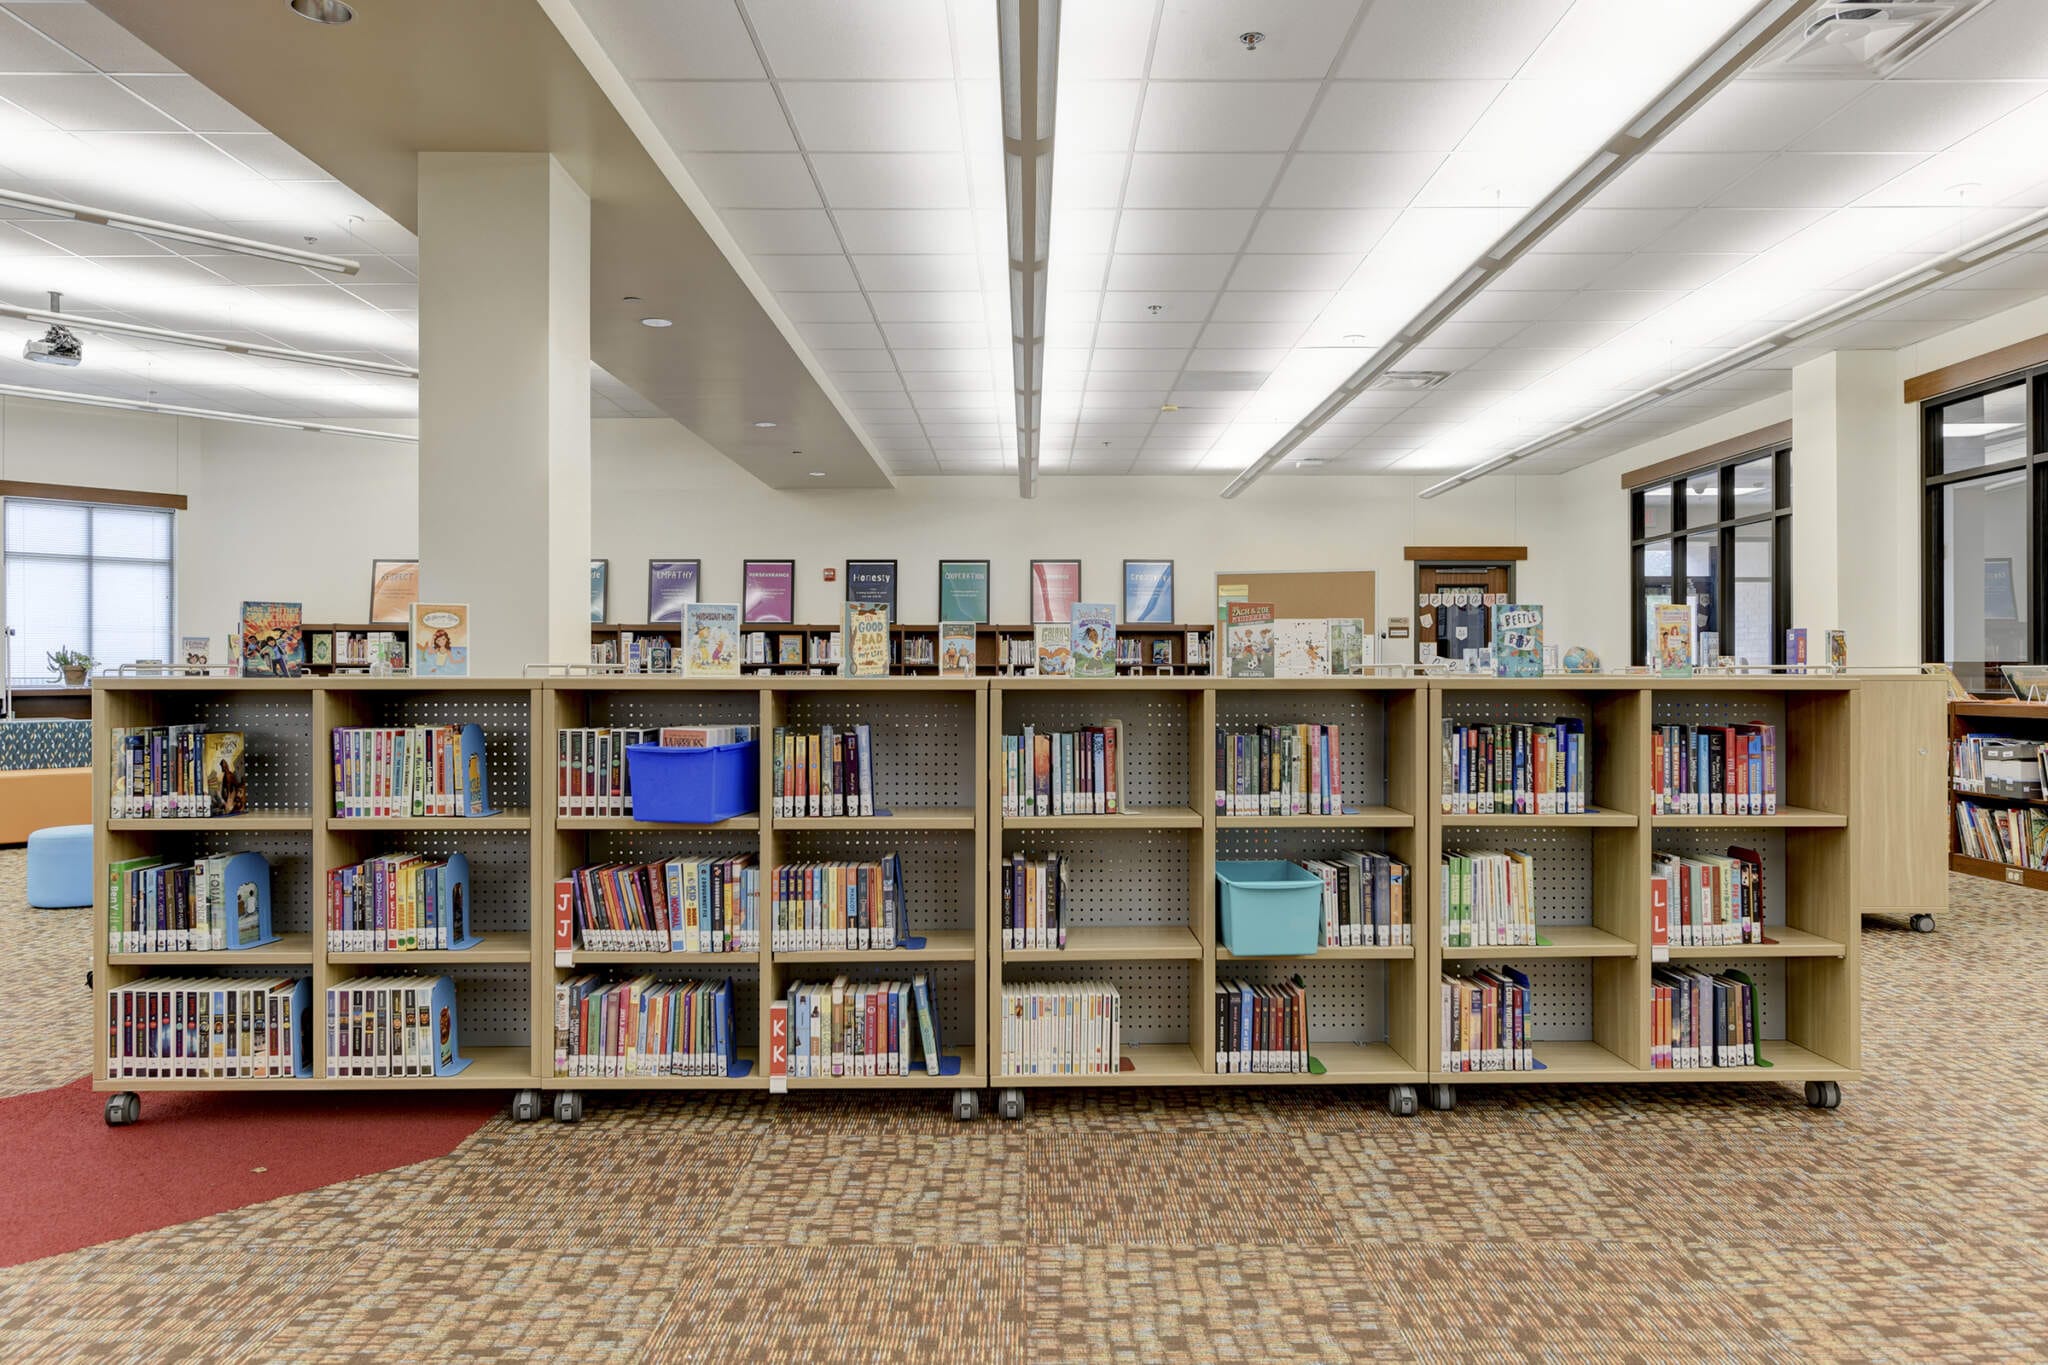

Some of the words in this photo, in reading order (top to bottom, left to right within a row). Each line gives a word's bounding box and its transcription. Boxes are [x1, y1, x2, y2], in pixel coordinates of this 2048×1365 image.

[656, 570, 693, 580] EMPATHY
[853, 573, 891, 583] Honesty
[858, 621, 884, 633] GOOD
[1504, 612, 1537, 627] BEETLE
[861, 632, 883, 646] BAD
[110, 885, 119, 902] Ben
[376, 872, 384, 925] BUSTER
[688, 885, 697, 901] KID
[1654, 890, 1665, 908] L
[1732, 883, 1740, 898] PIE
[558, 893, 571, 912] J
[557, 919, 571, 938] J
[1654, 915, 1666, 933] L
[773, 1019, 785, 1037] K
[773, 1045, 785, 1064] K
